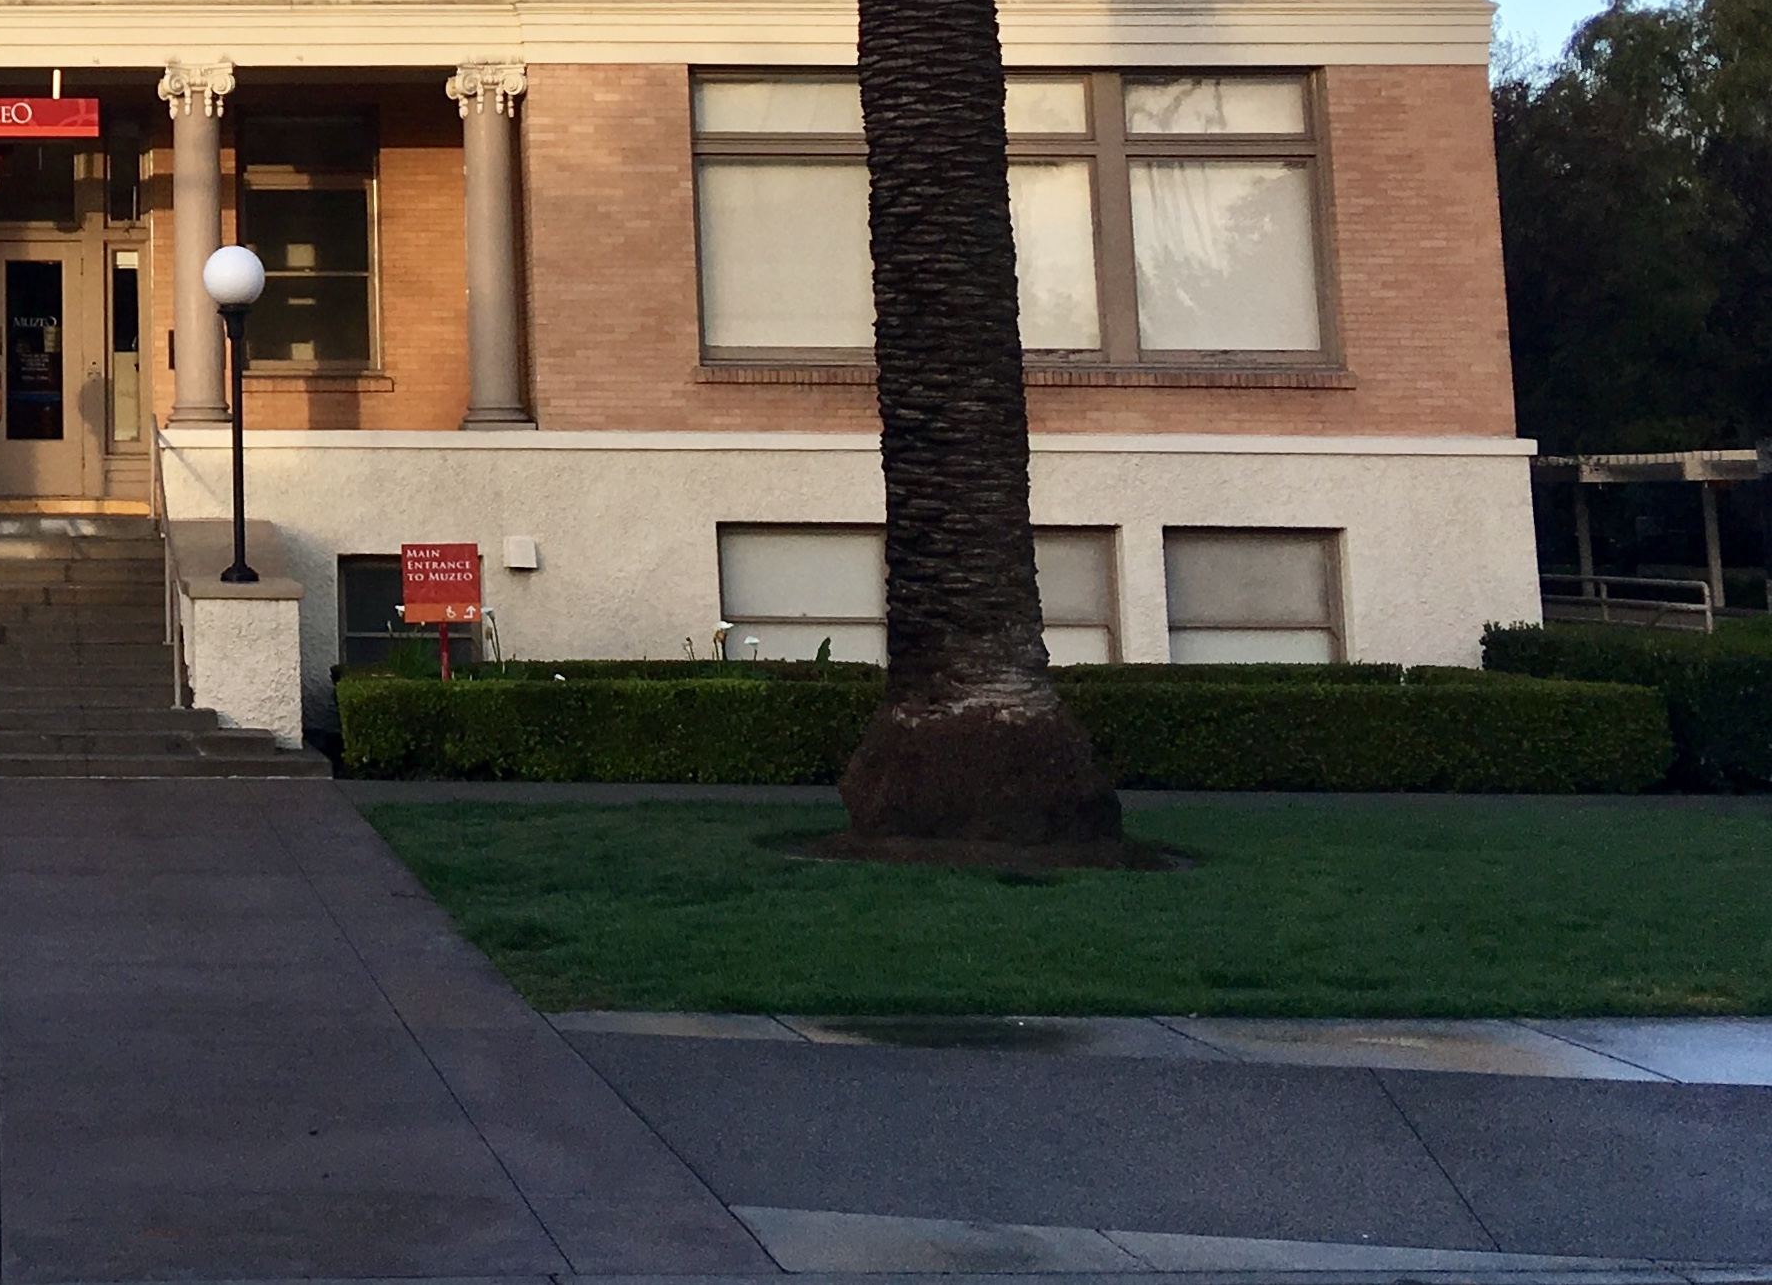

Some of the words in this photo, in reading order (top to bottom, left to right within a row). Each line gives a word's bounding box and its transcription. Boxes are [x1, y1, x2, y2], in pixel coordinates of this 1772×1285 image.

[406, 549, 441, 558] MAIN
[407, 560, 472, 570] ENTRANCE
[407, 573, 425, 582] TO
[428, 571, 474, 581] MUZEO
